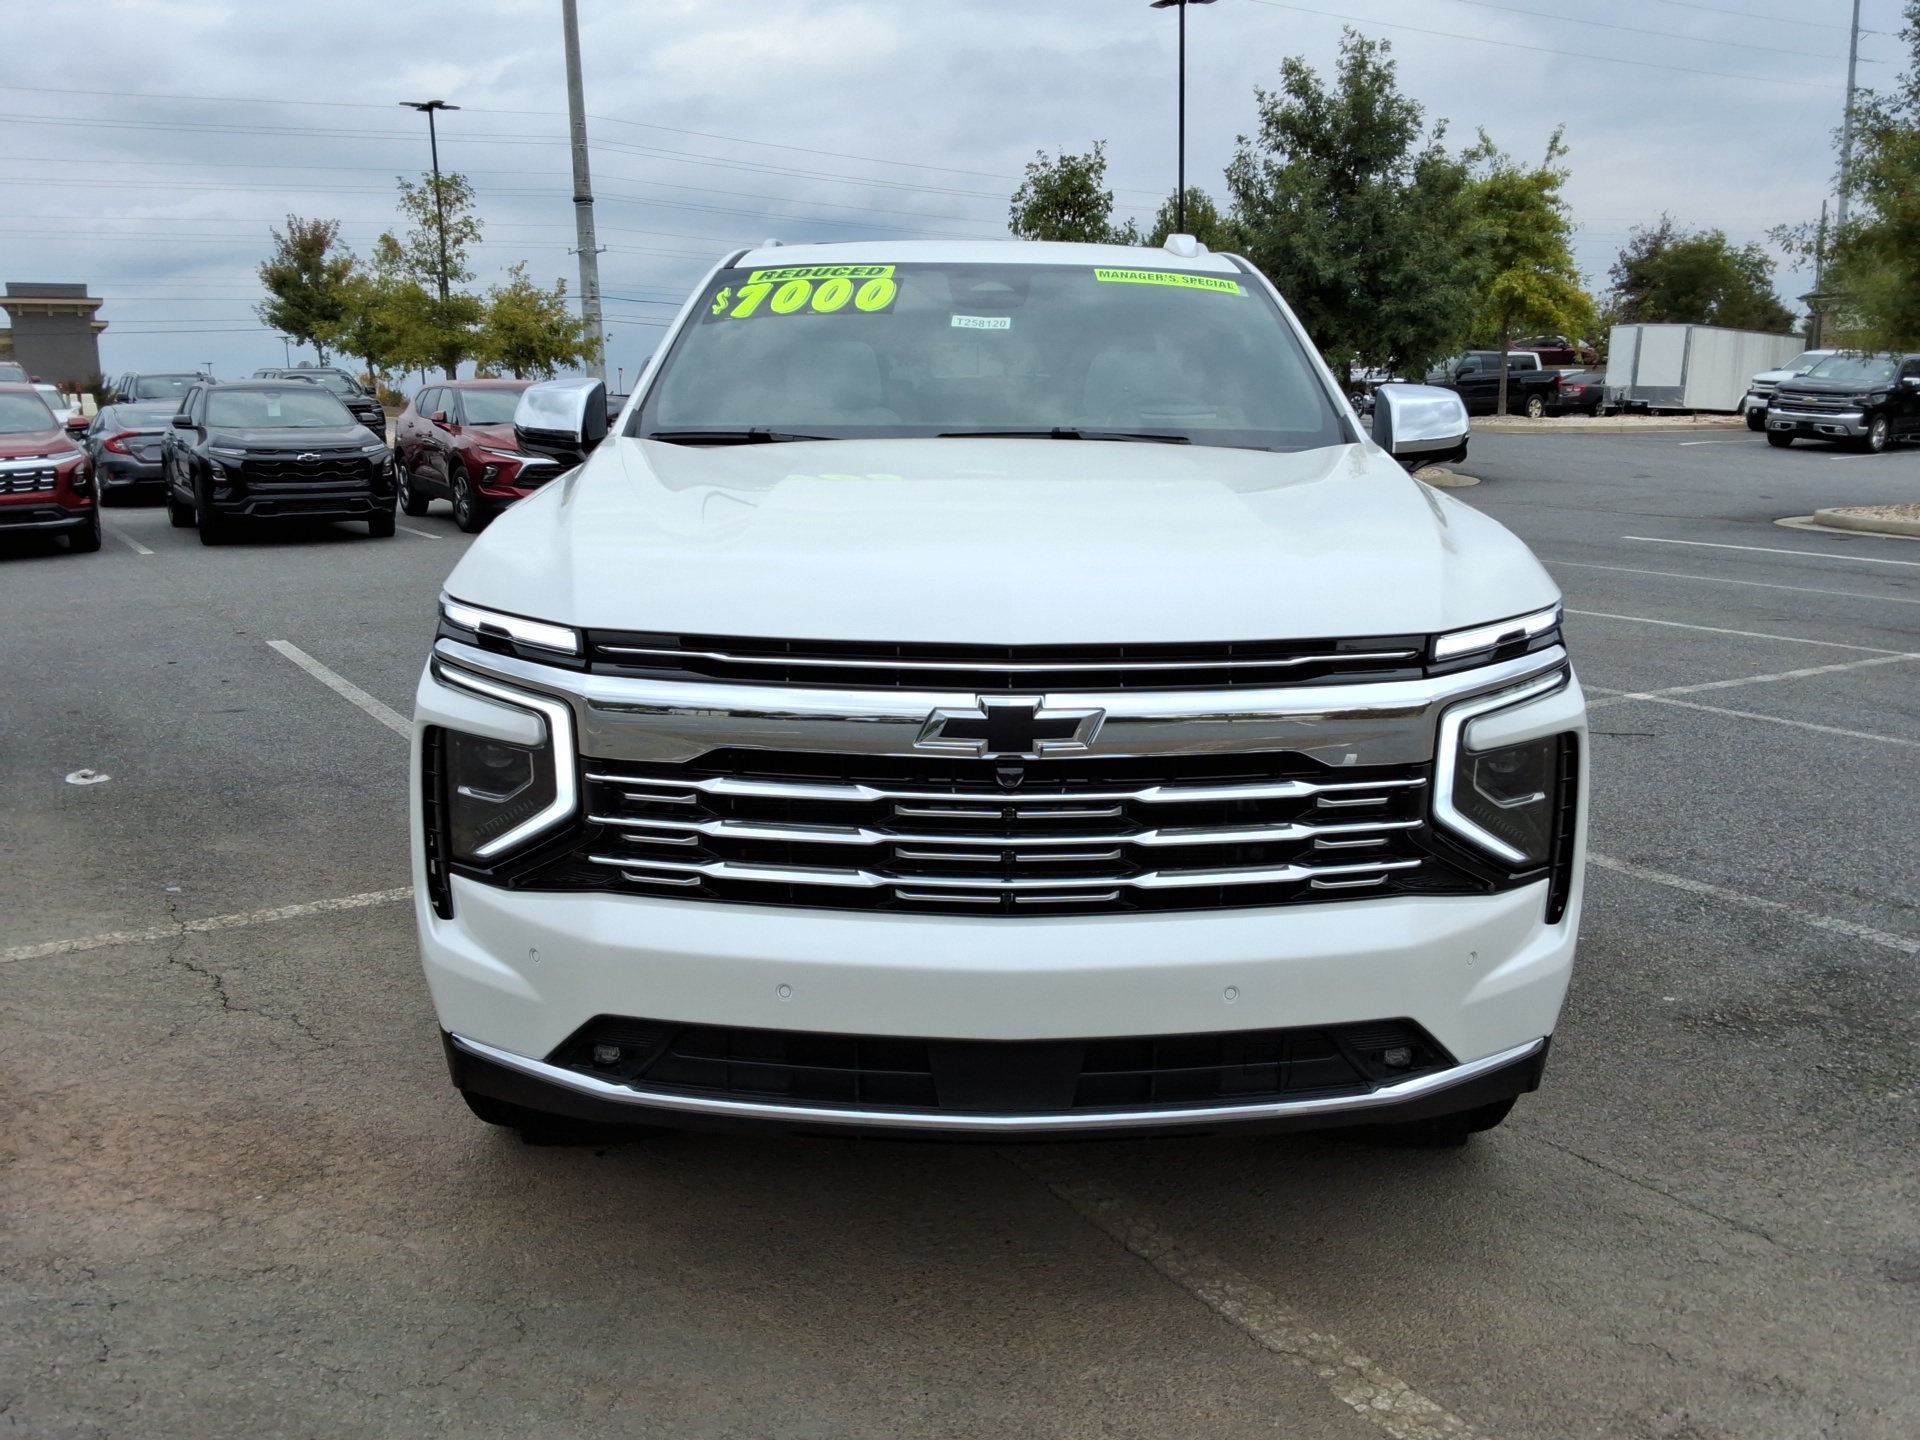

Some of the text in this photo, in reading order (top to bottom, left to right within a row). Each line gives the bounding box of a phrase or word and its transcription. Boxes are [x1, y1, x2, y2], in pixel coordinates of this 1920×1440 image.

[756, 266, 888, 281] REDUCED
[1098, 269, 1235, 290] MANAGER'S SPECIAL
